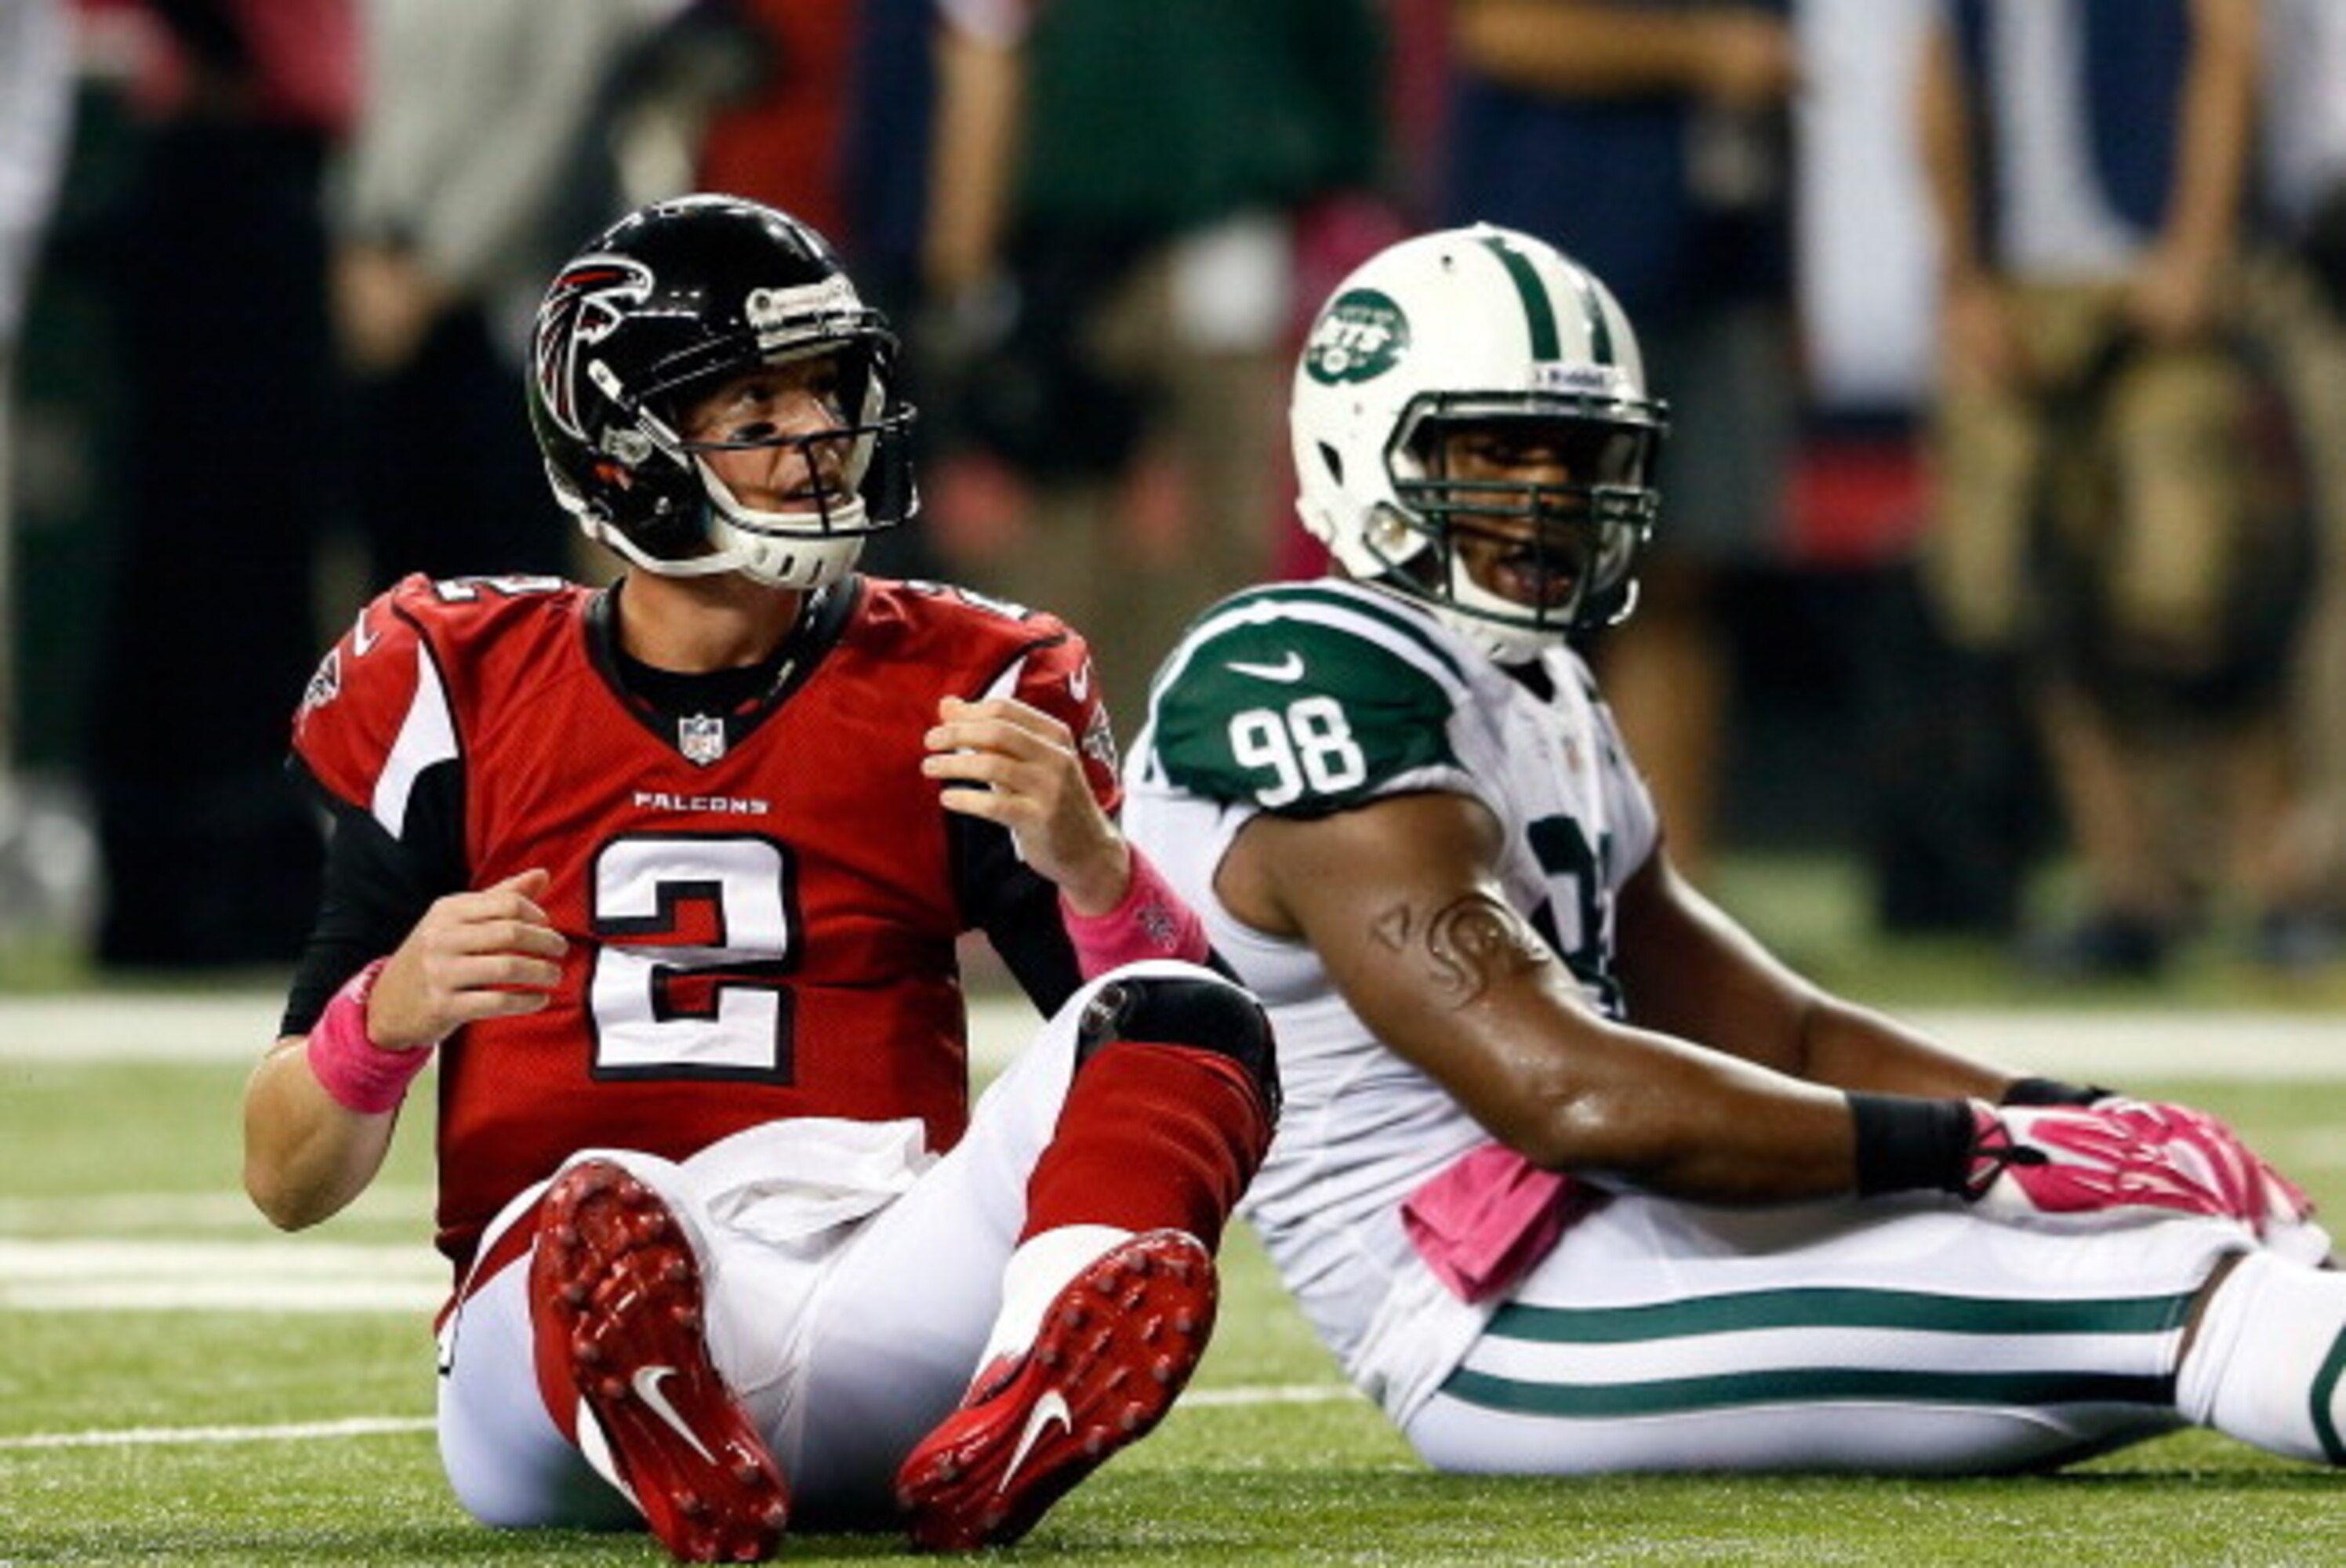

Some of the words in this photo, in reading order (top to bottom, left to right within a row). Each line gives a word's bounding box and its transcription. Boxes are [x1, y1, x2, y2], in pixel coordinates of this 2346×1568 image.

[634, 791, 768, 815] FALCONS
[1228, 695, 1367, 808] 98
[592, 839, 788, 1070] 2
